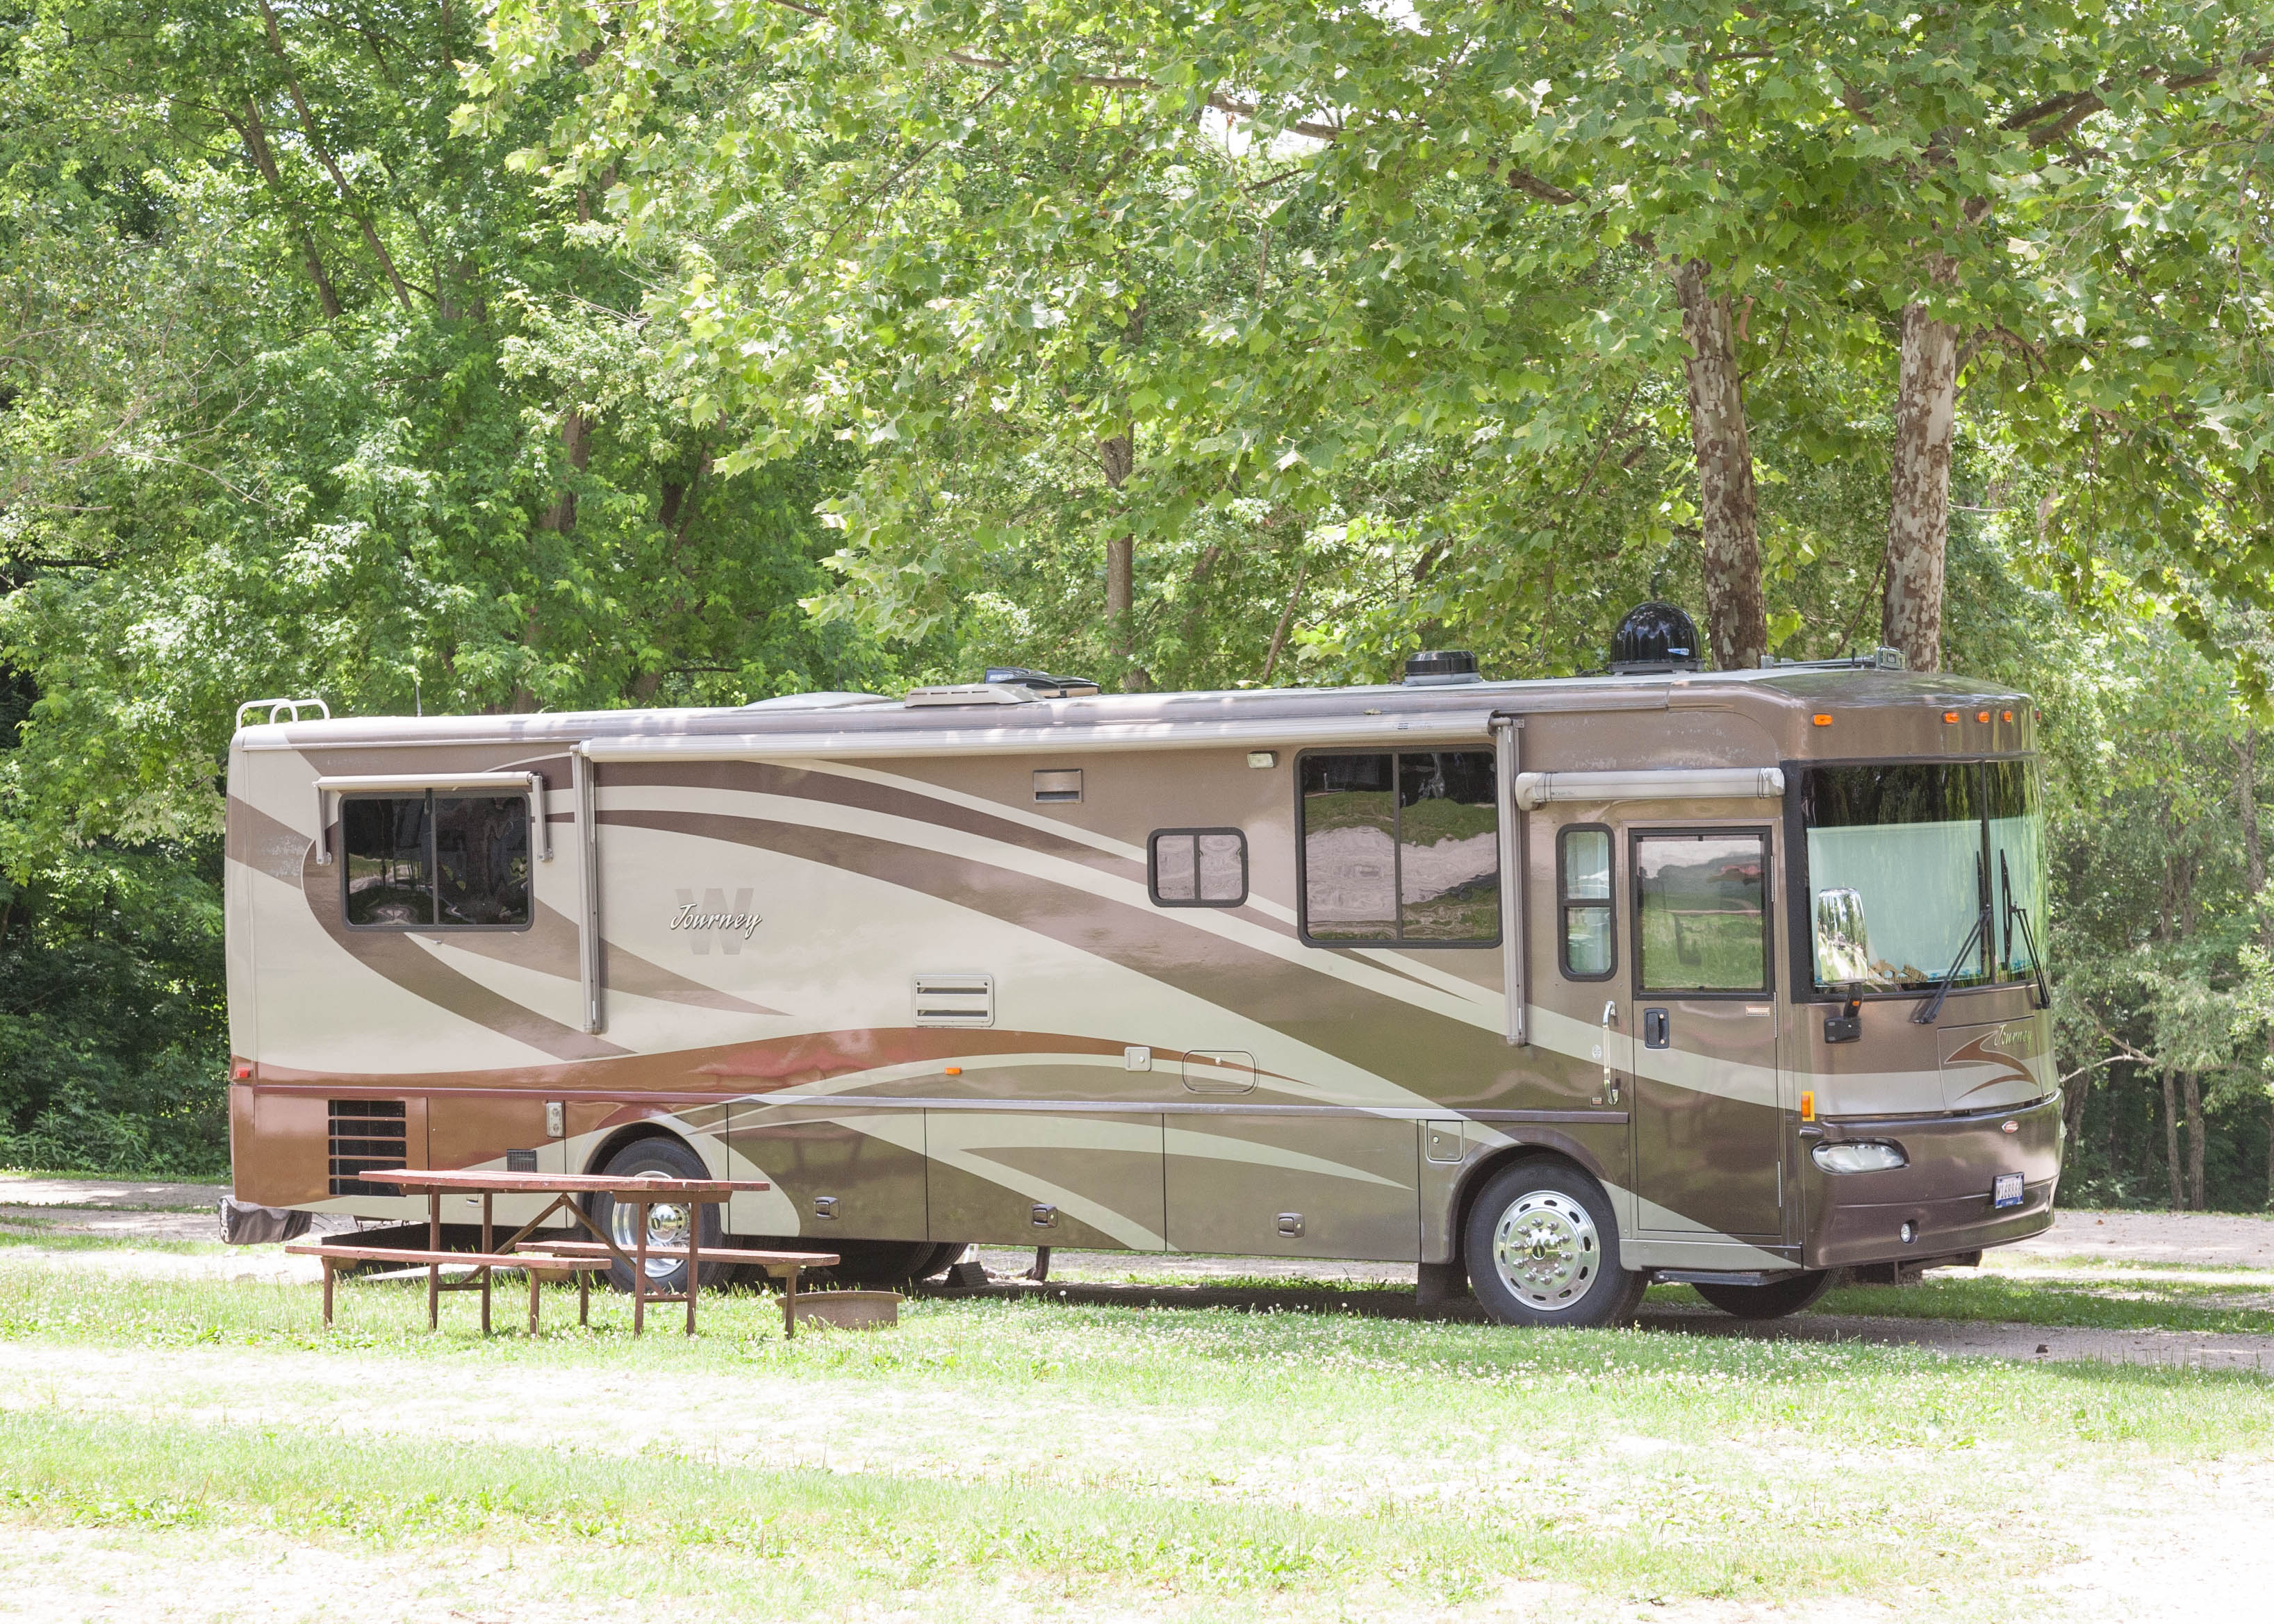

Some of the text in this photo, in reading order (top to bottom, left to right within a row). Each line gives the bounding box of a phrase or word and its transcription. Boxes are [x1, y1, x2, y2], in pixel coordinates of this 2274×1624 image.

[670, 903, 762, 939] Journey
[675, 888, 755, 956] W
[1994, 1024, 2034, 1050] Journey
